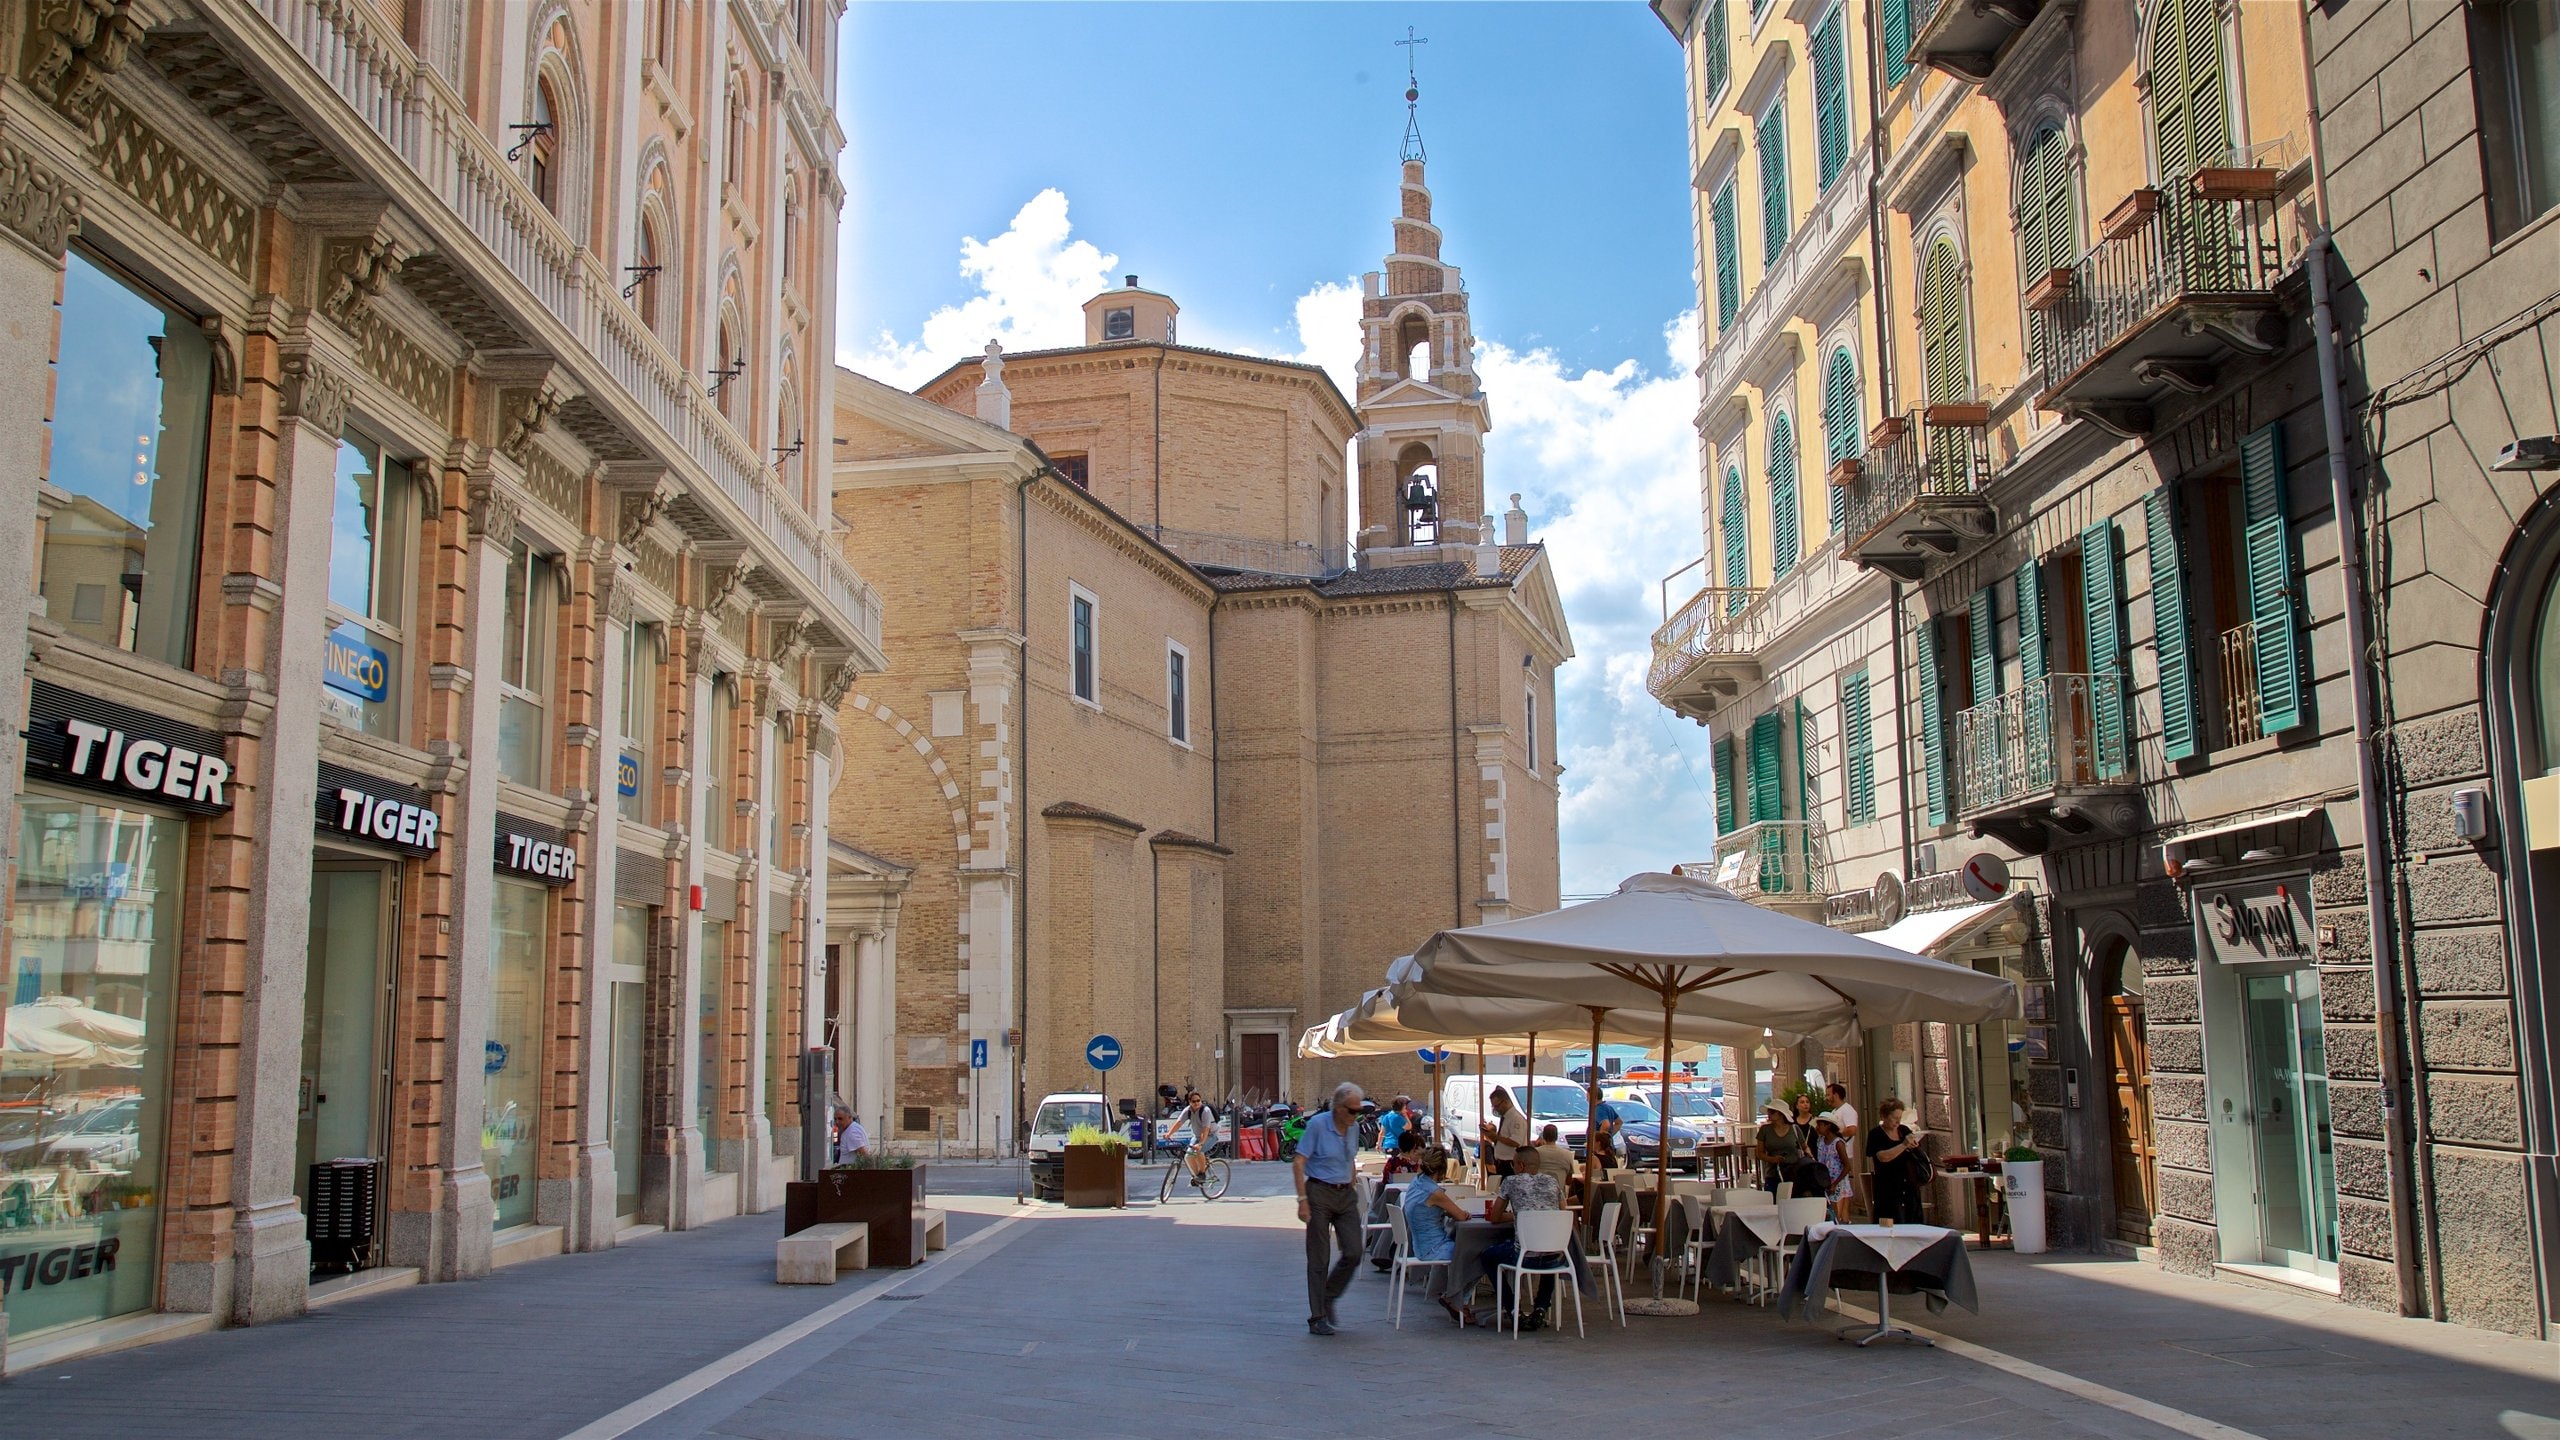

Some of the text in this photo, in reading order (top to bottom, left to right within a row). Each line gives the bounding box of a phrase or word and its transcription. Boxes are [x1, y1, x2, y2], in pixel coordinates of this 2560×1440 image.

[67, 719, 228, 805] TIGER
[340, 787, 438, 849] TIGER
[509, 833, 576, 880] TIGER
[0, 1238, 120, 1296] TIGER
